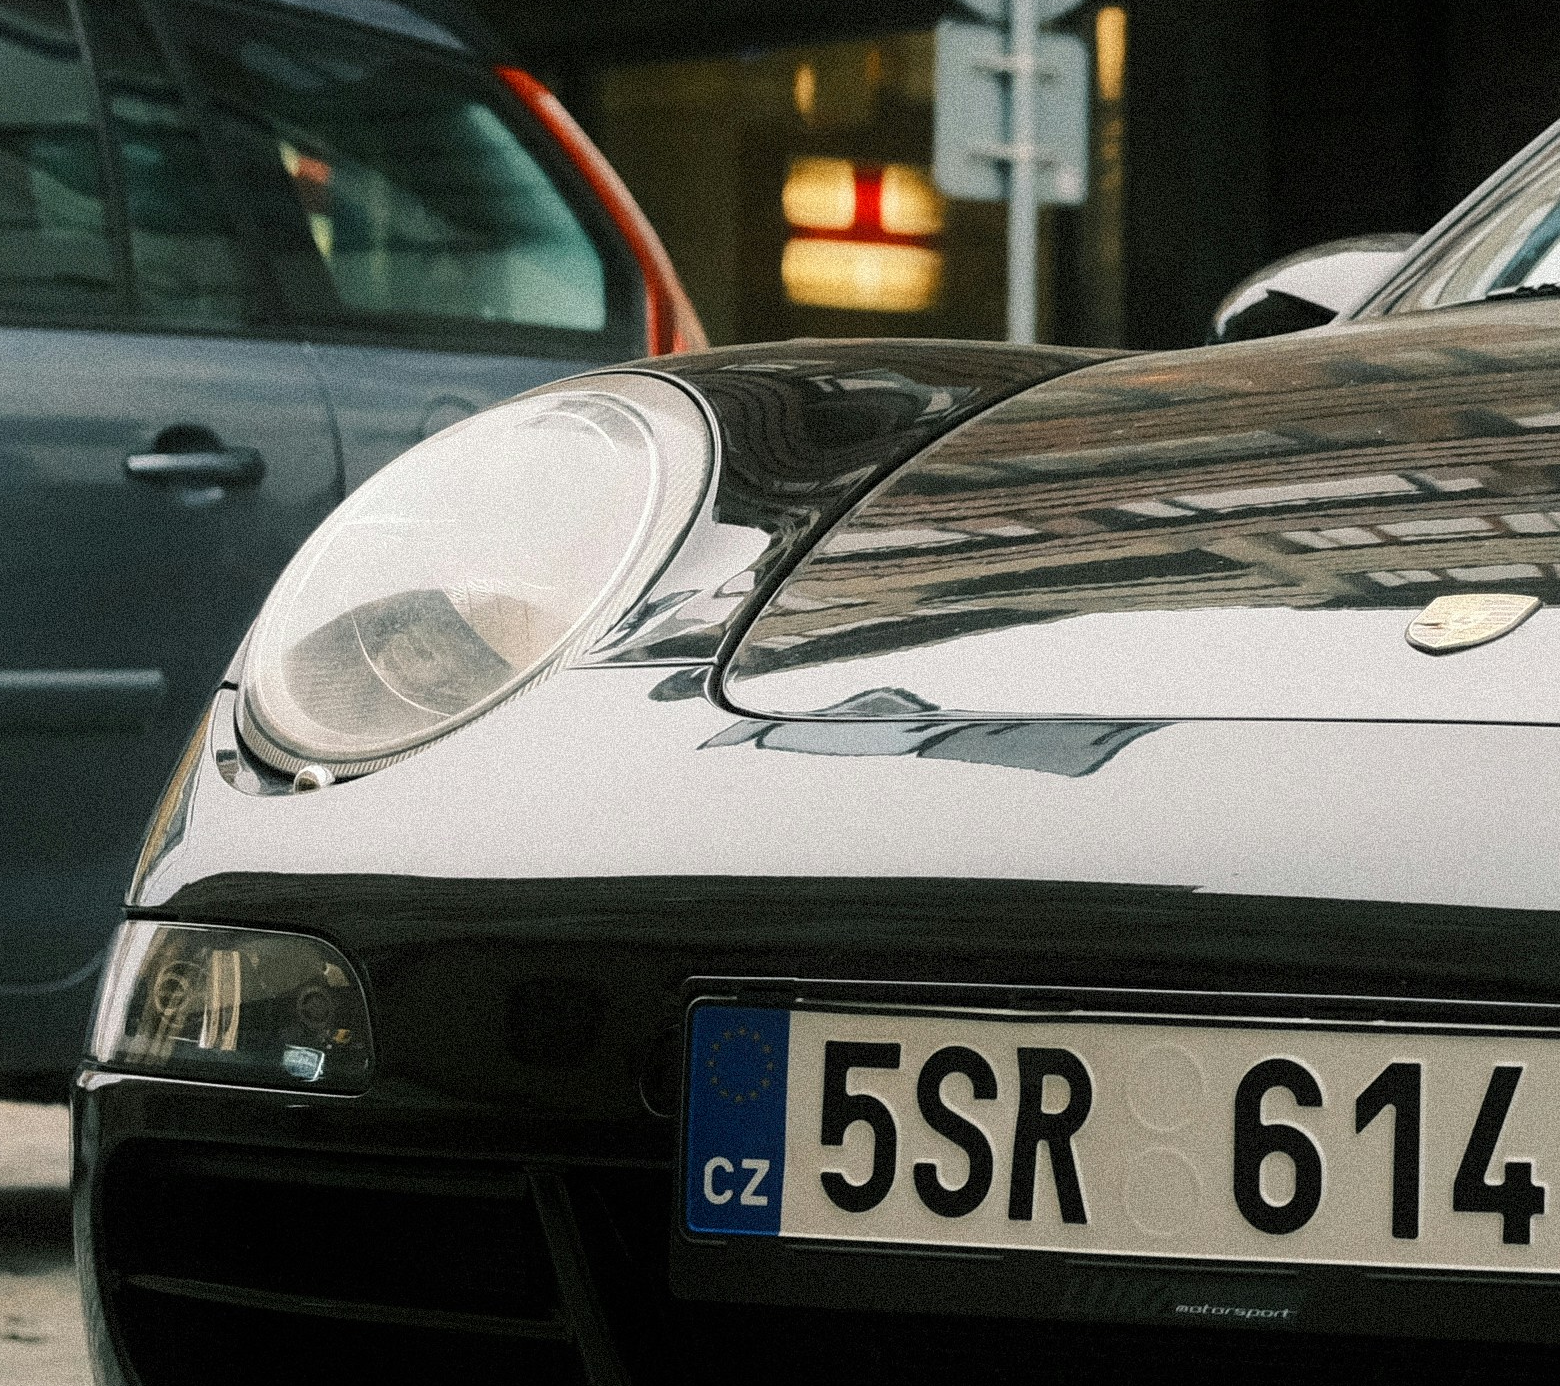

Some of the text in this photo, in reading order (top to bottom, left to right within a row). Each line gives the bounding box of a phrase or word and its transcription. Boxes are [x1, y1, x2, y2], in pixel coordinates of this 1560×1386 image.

[818, 1039, 1095, 1225] 5SR
[703, 1156, 771, 1206] CZ
[1175, 1303, 1291, 1319] motorsport
